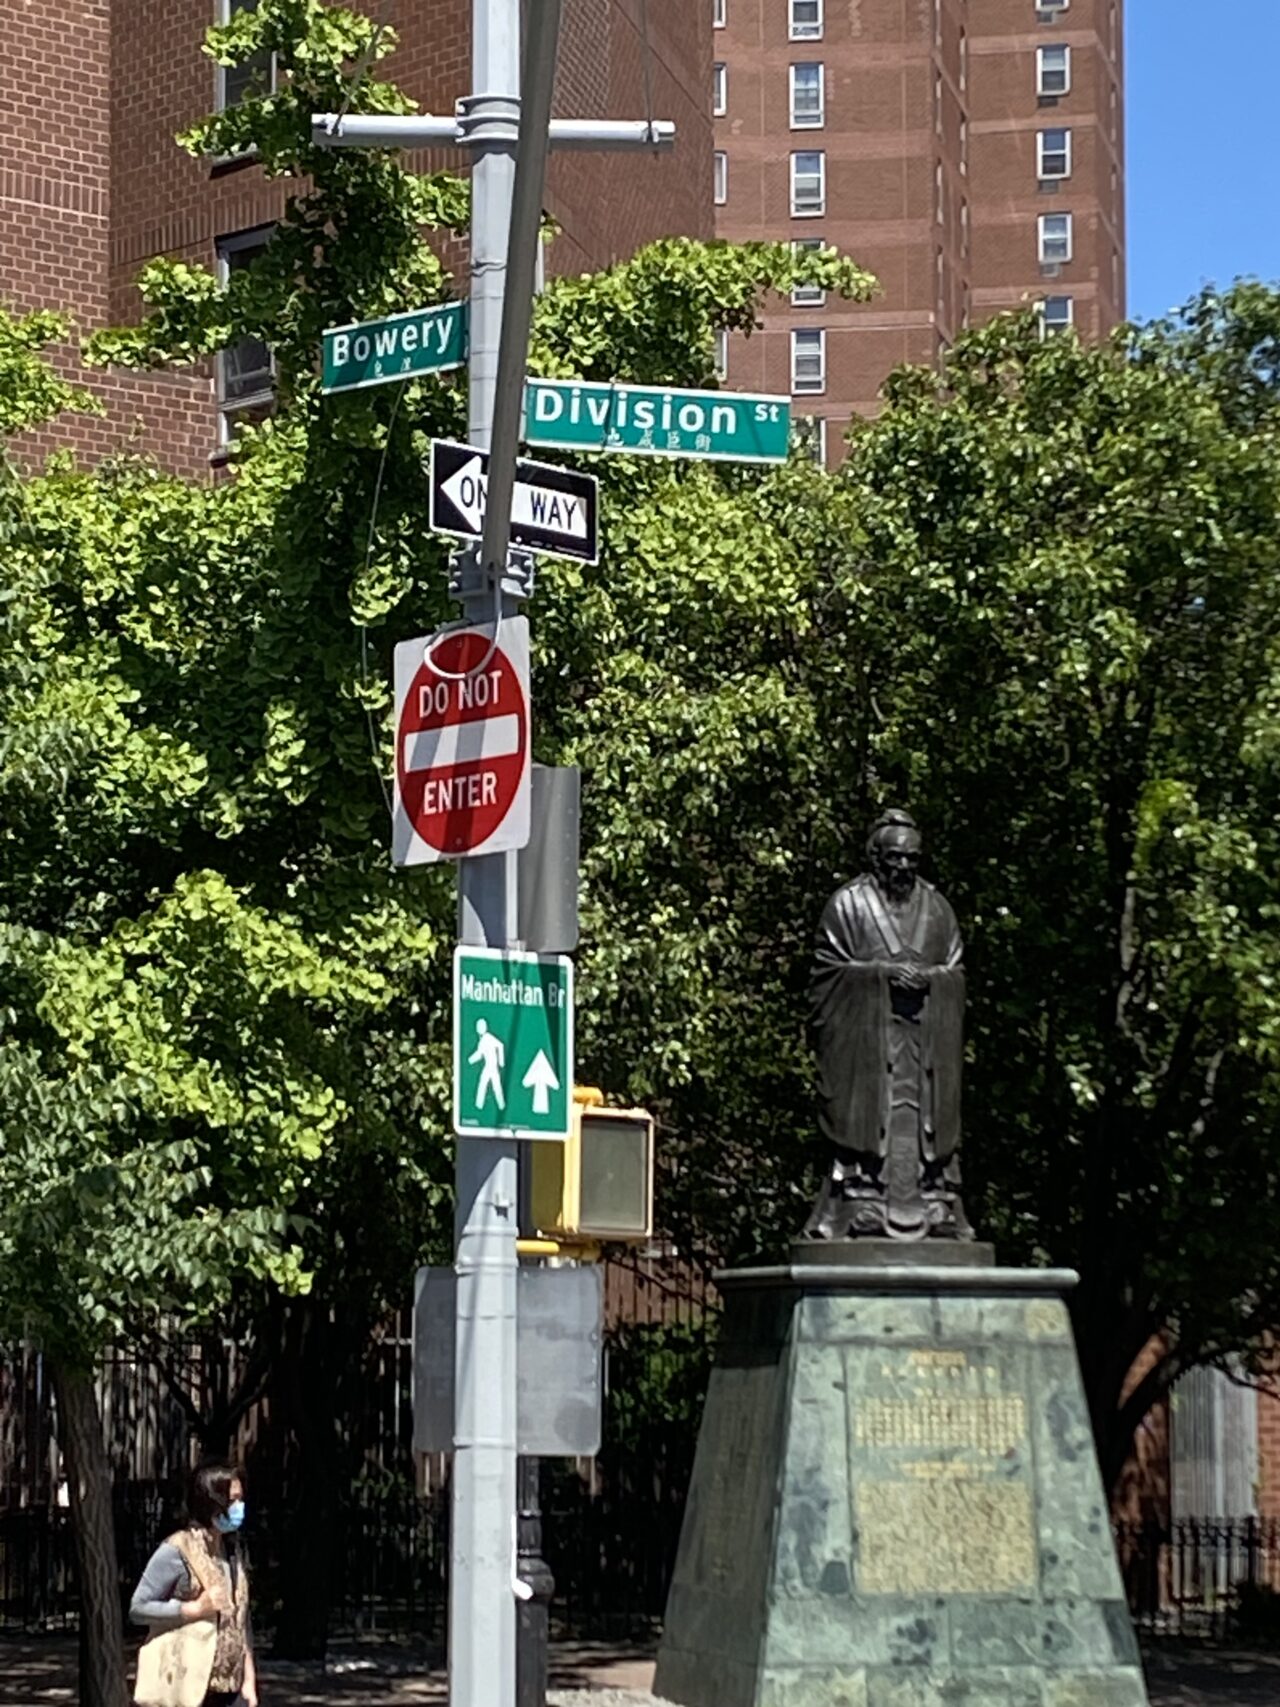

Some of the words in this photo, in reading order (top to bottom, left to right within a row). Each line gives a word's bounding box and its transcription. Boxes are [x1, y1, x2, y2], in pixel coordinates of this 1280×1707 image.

[333, 316, 453, 366] Bowery
[535, 388, 736, 434] Division
[755, 403, 779, 422] St
[460, 476, 487, 510] ON
[531, 491, 577, 530] WAY
[419, 682, 448, 718] DO
[458, 670, 502, 710] NOT
[423, 771, 497, 815] ENTER
[461, 974, 543, 1006] Manhattan
[548, 982, 565, 1008] Br
